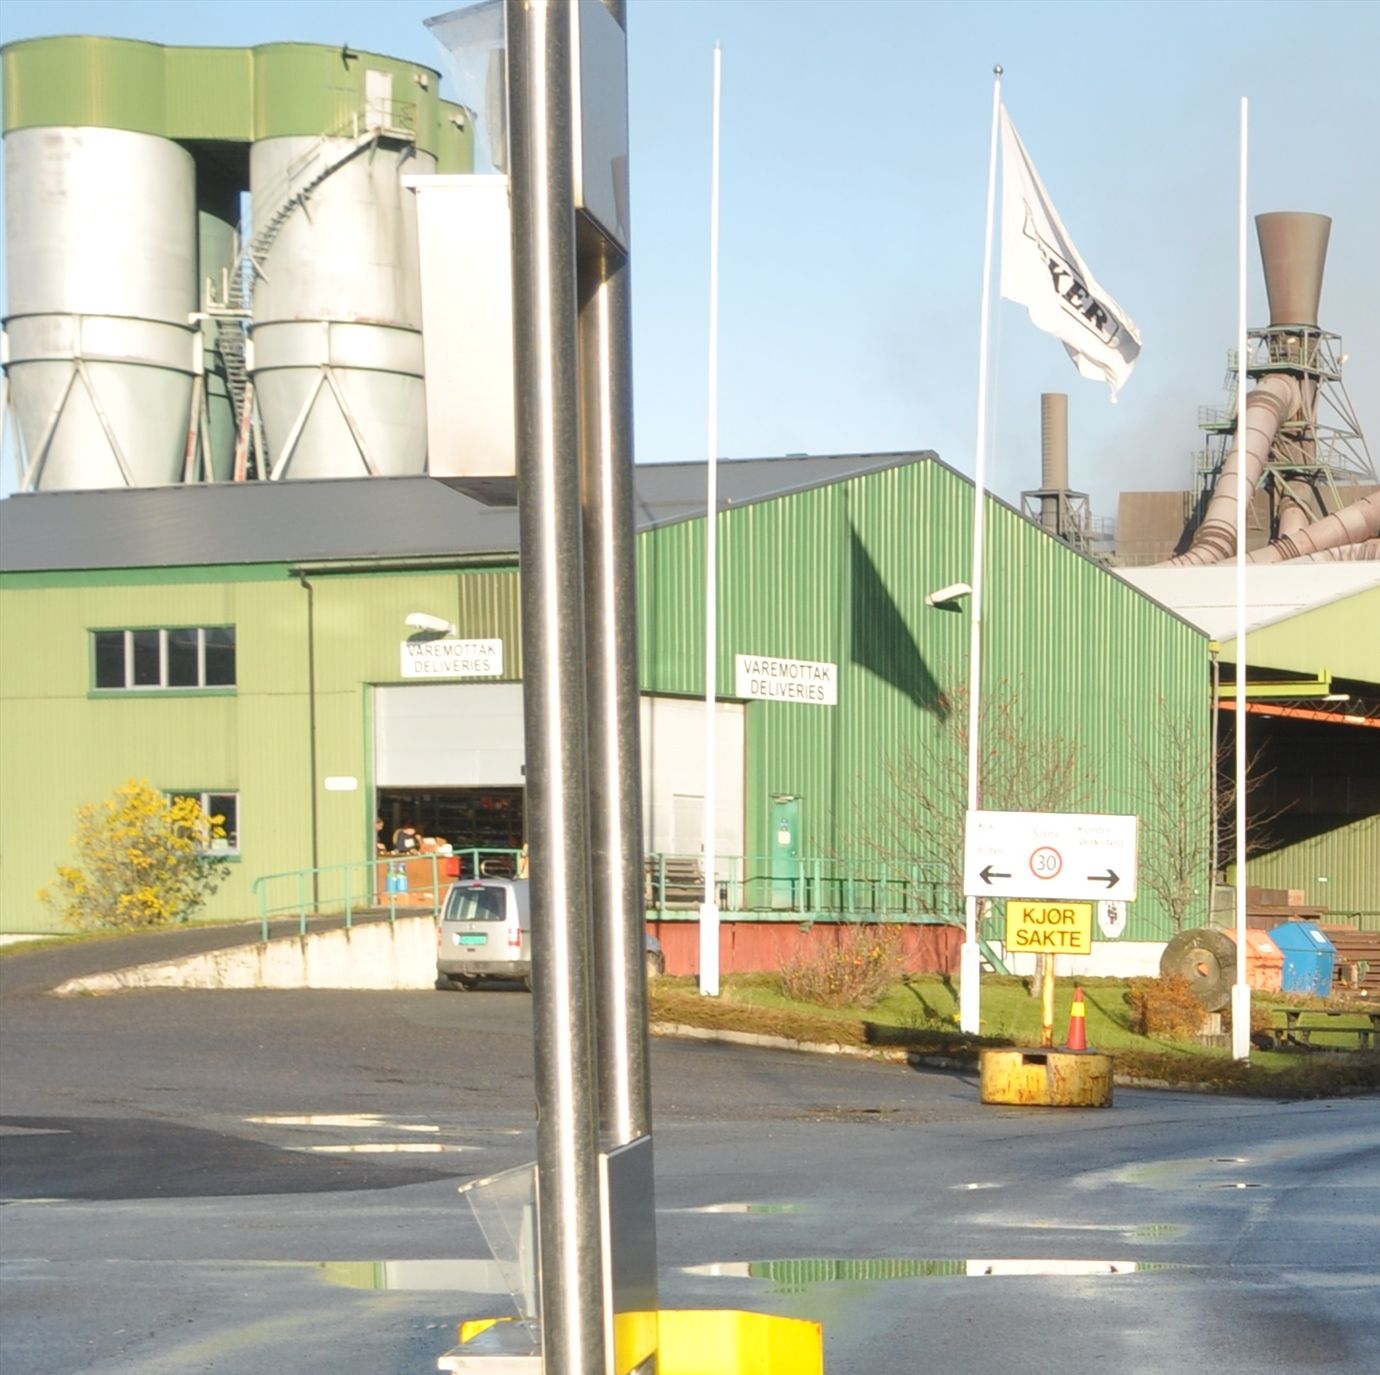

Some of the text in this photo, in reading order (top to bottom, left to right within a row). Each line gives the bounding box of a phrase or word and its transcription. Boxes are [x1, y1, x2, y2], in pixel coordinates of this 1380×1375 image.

[406, 643, 496, 657] VAREMOTTAK
[414, 659, 491, 673] DELIVERIES
[743, 659, 831, 682] VAREMOTTAK
[750, 679, 825, 701] DELIVERIES
[1036, 854, 1057, 871] 30
[1023, 907, 1075, 925] KJØR
[1016, 929, 1082, 947] SAKTE
